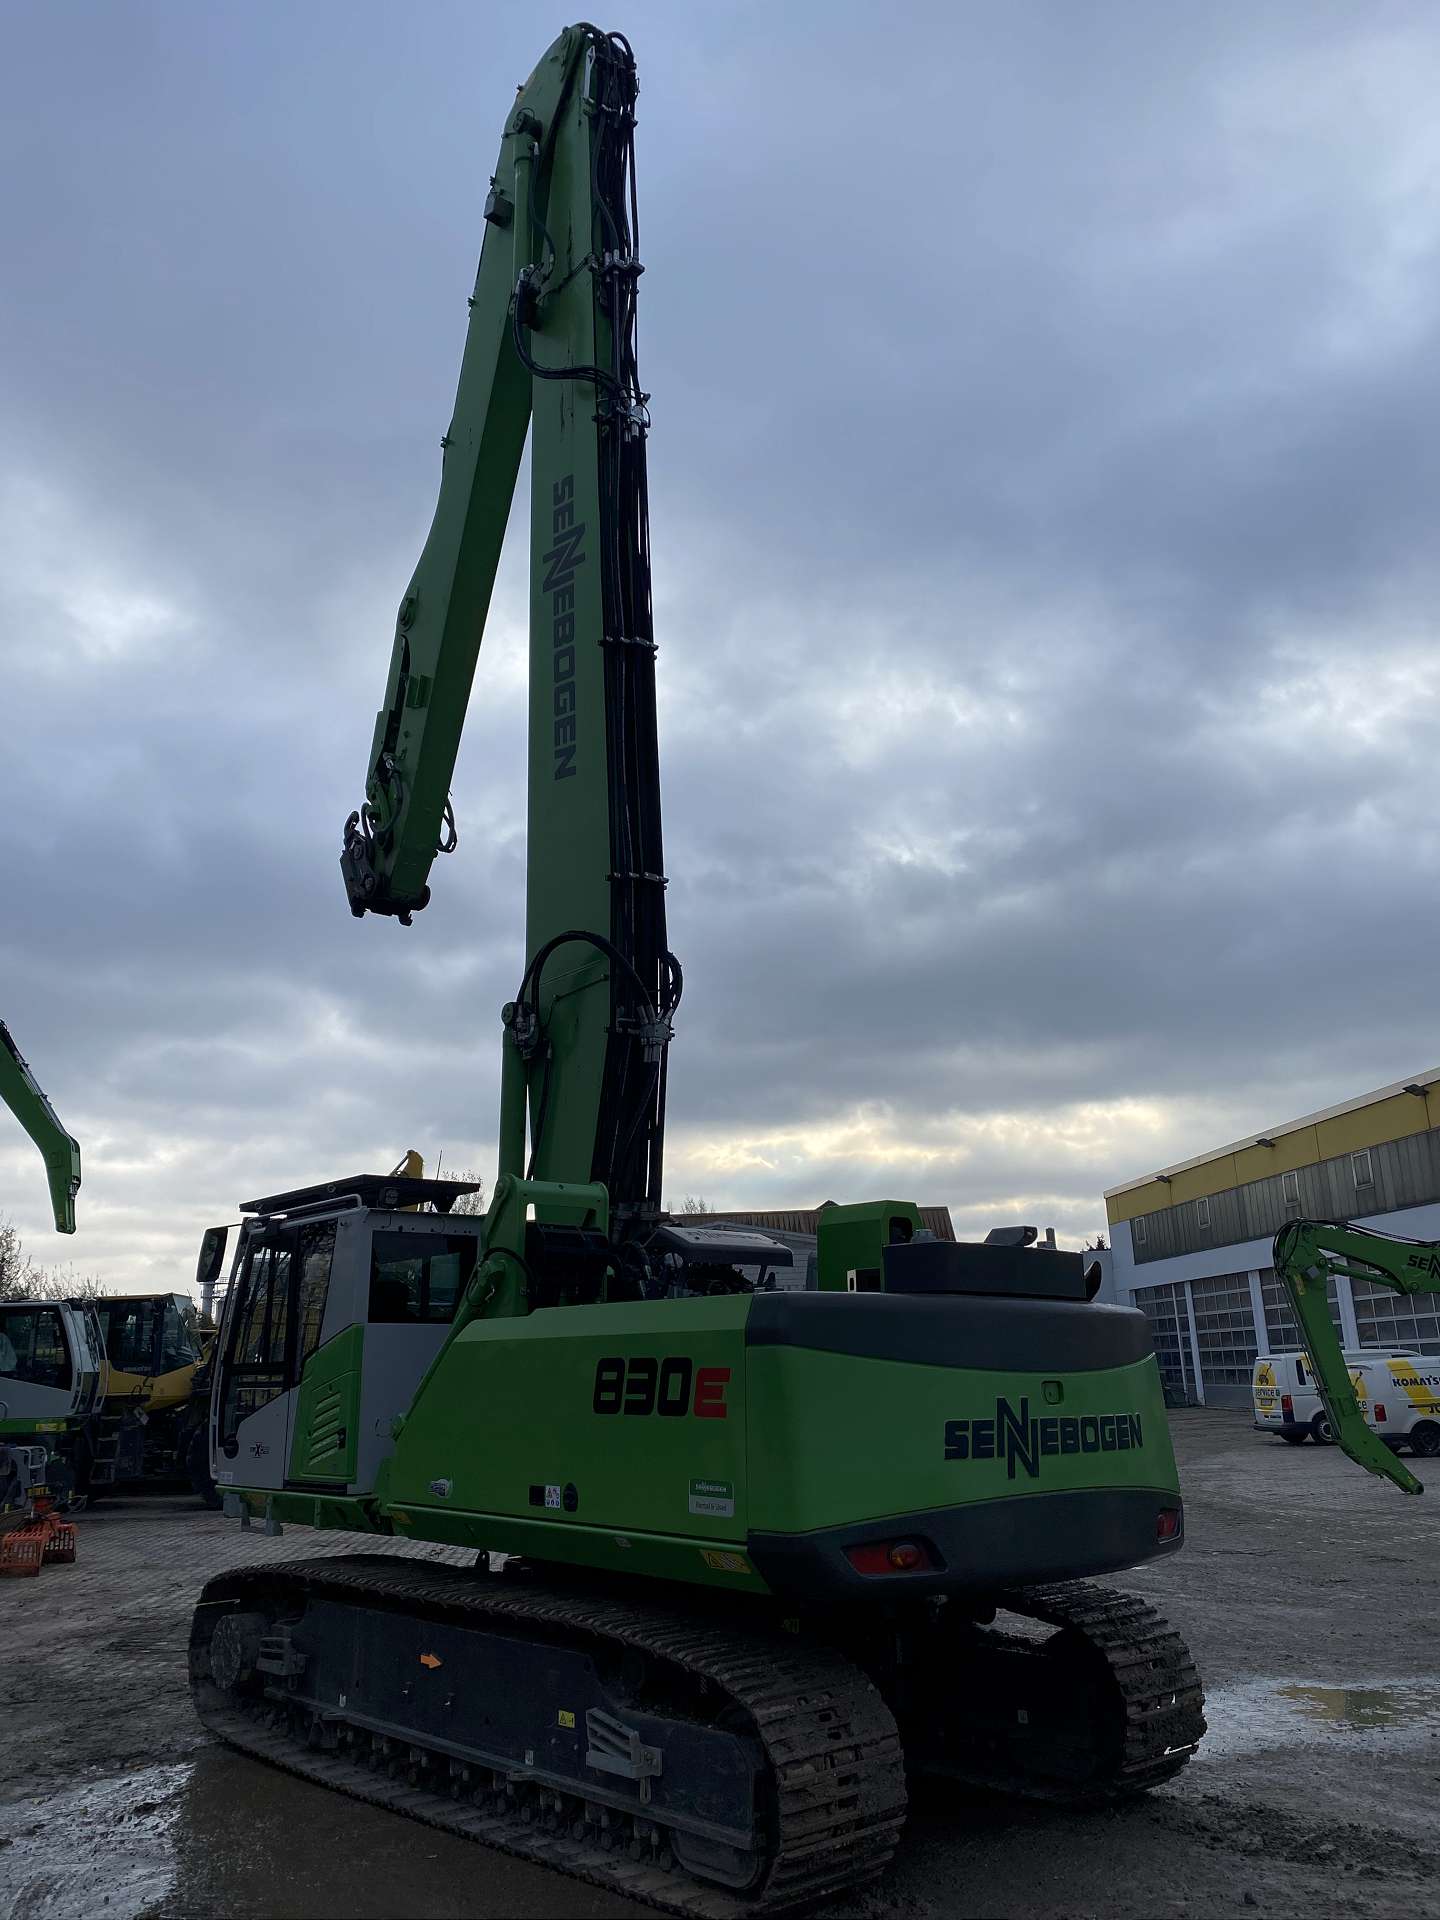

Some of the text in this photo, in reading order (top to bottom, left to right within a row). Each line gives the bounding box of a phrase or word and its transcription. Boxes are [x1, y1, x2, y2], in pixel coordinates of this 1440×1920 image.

[542, 474, 586, 781] SENNEBOGEN
[593, 1357, 731, 1418] 830E
[1392, 1375, 1440, 1387] KOMATS
[944, 1397, 1143, 1480] SENNEBOGEN
